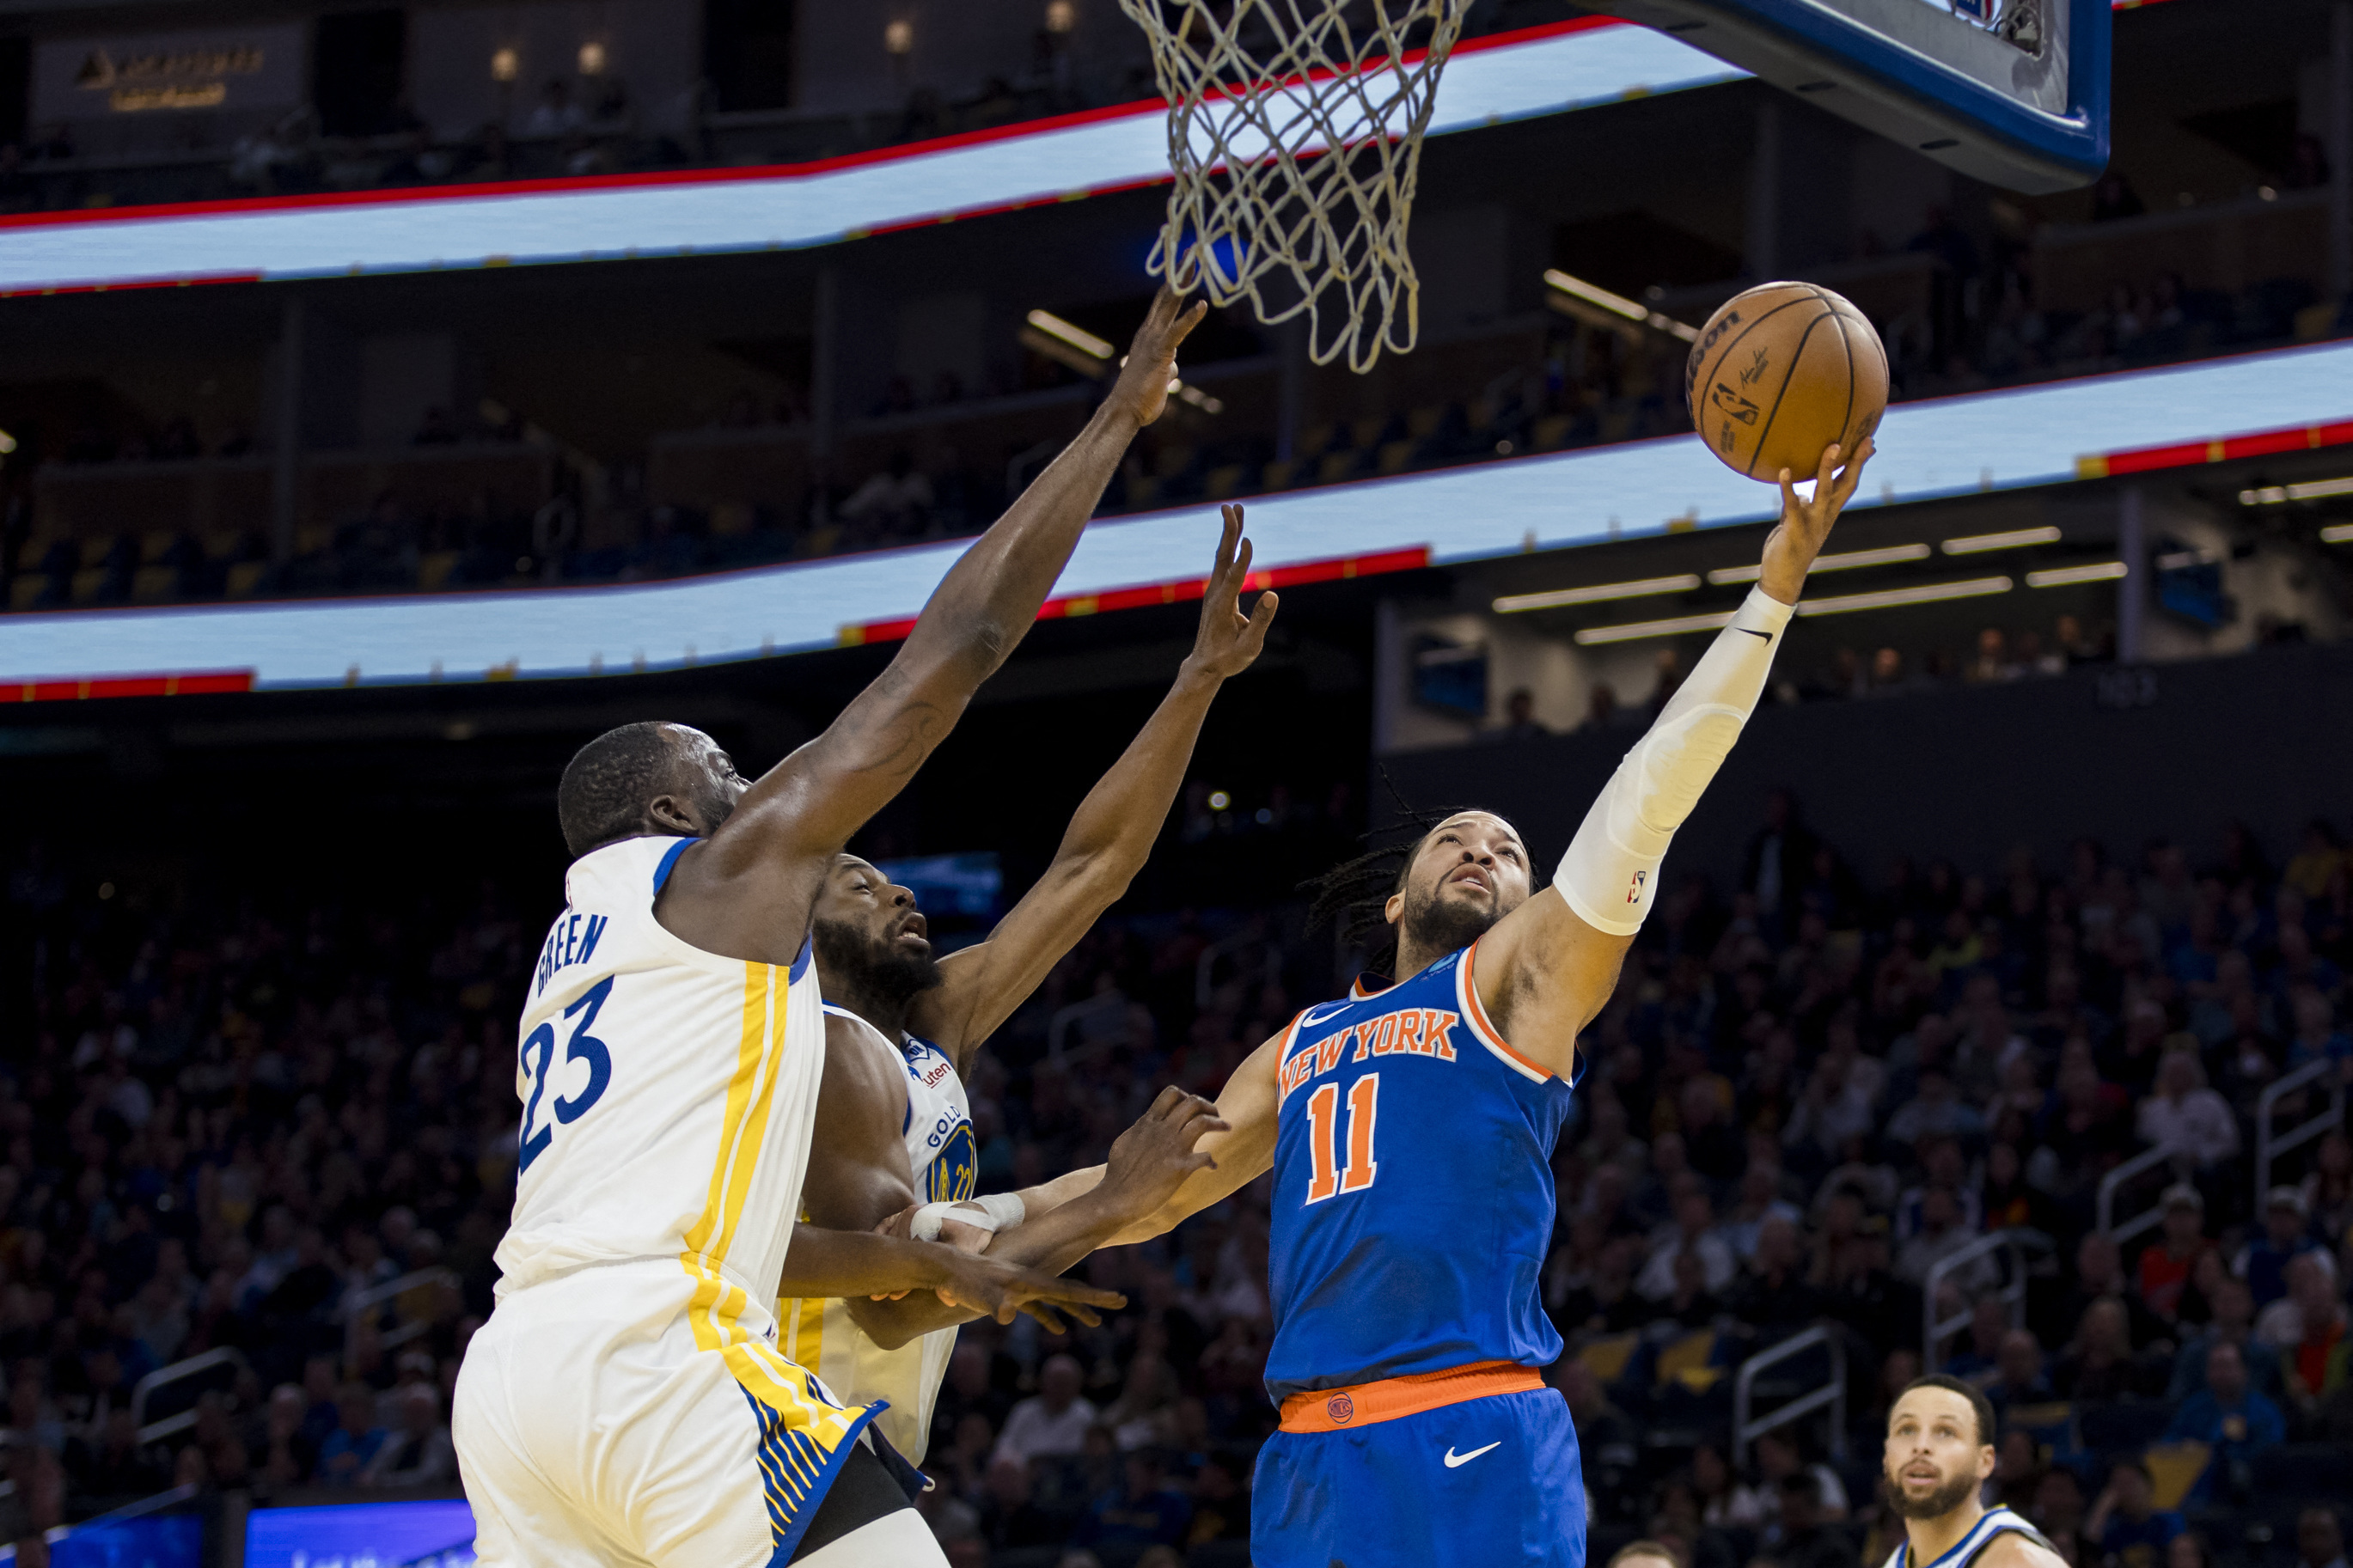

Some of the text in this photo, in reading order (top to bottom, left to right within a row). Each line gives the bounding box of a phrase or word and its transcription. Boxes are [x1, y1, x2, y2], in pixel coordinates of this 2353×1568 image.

[538, 914, 608, 998] GREEN
[520, 973, 615, 1177] 23
[1278, 1008, 1459, 1116] NEW YORK
[1305, 1072, 1379, 1206] 11
